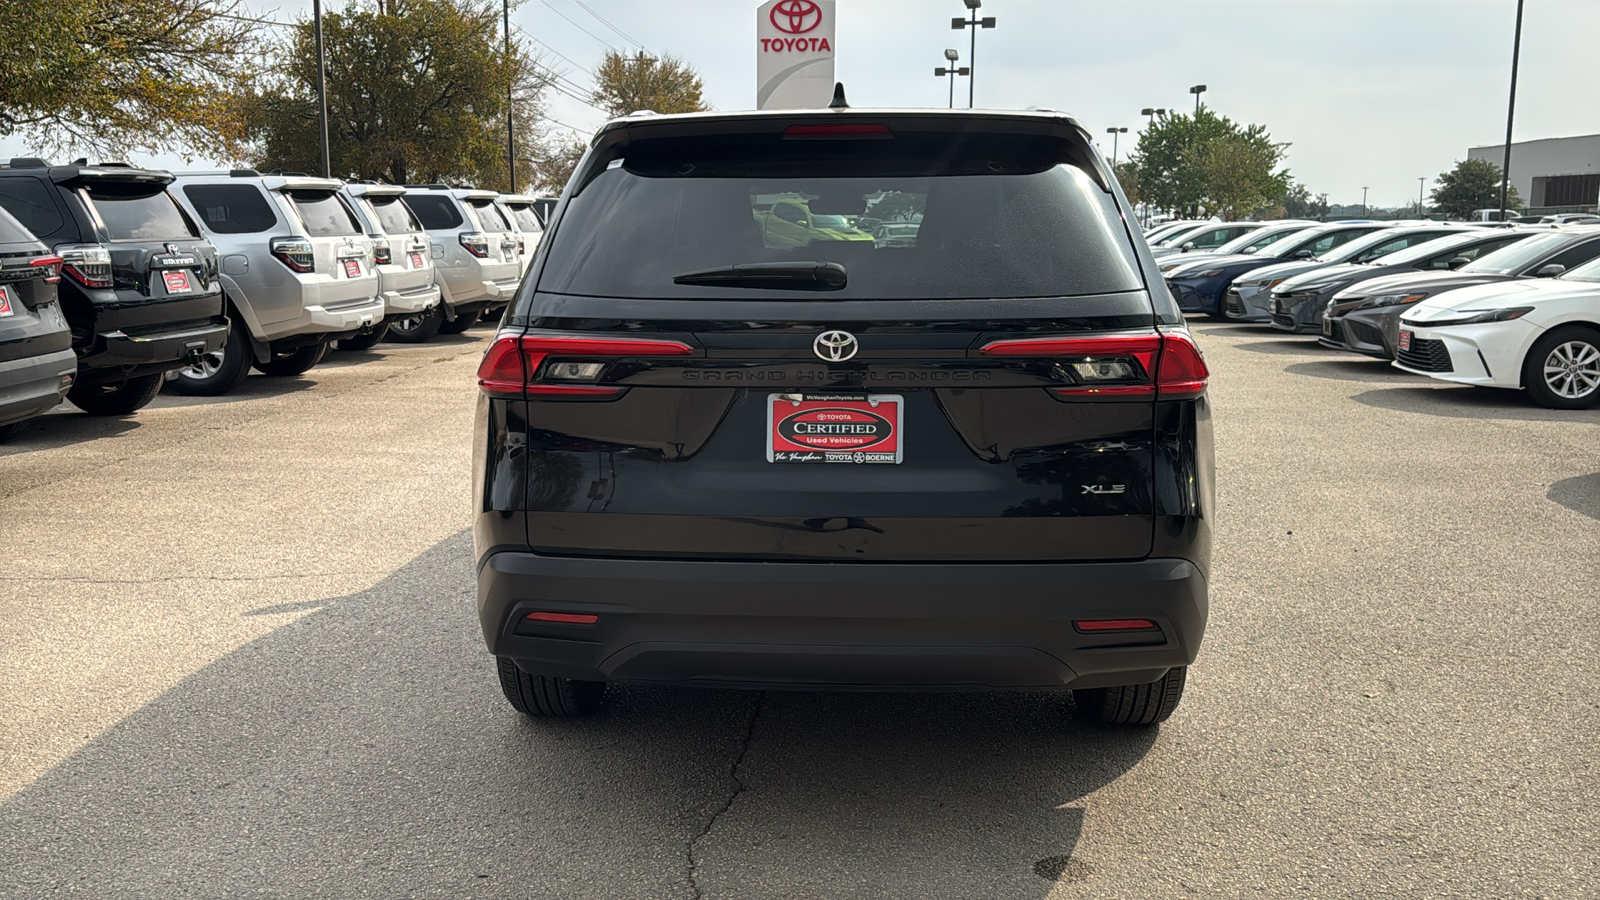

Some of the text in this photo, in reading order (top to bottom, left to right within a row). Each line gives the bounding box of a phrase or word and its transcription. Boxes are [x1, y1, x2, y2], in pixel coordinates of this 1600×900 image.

[760, 37, 831, 52] TOYOTA
[681, 370, 993, 381] GRAND HIGHLANDER
[774, 451, 823, 462] Vic Vaughan
[865, 453, 895, 461] BOERNE
[1080, 484, 1126, 494] XLE
